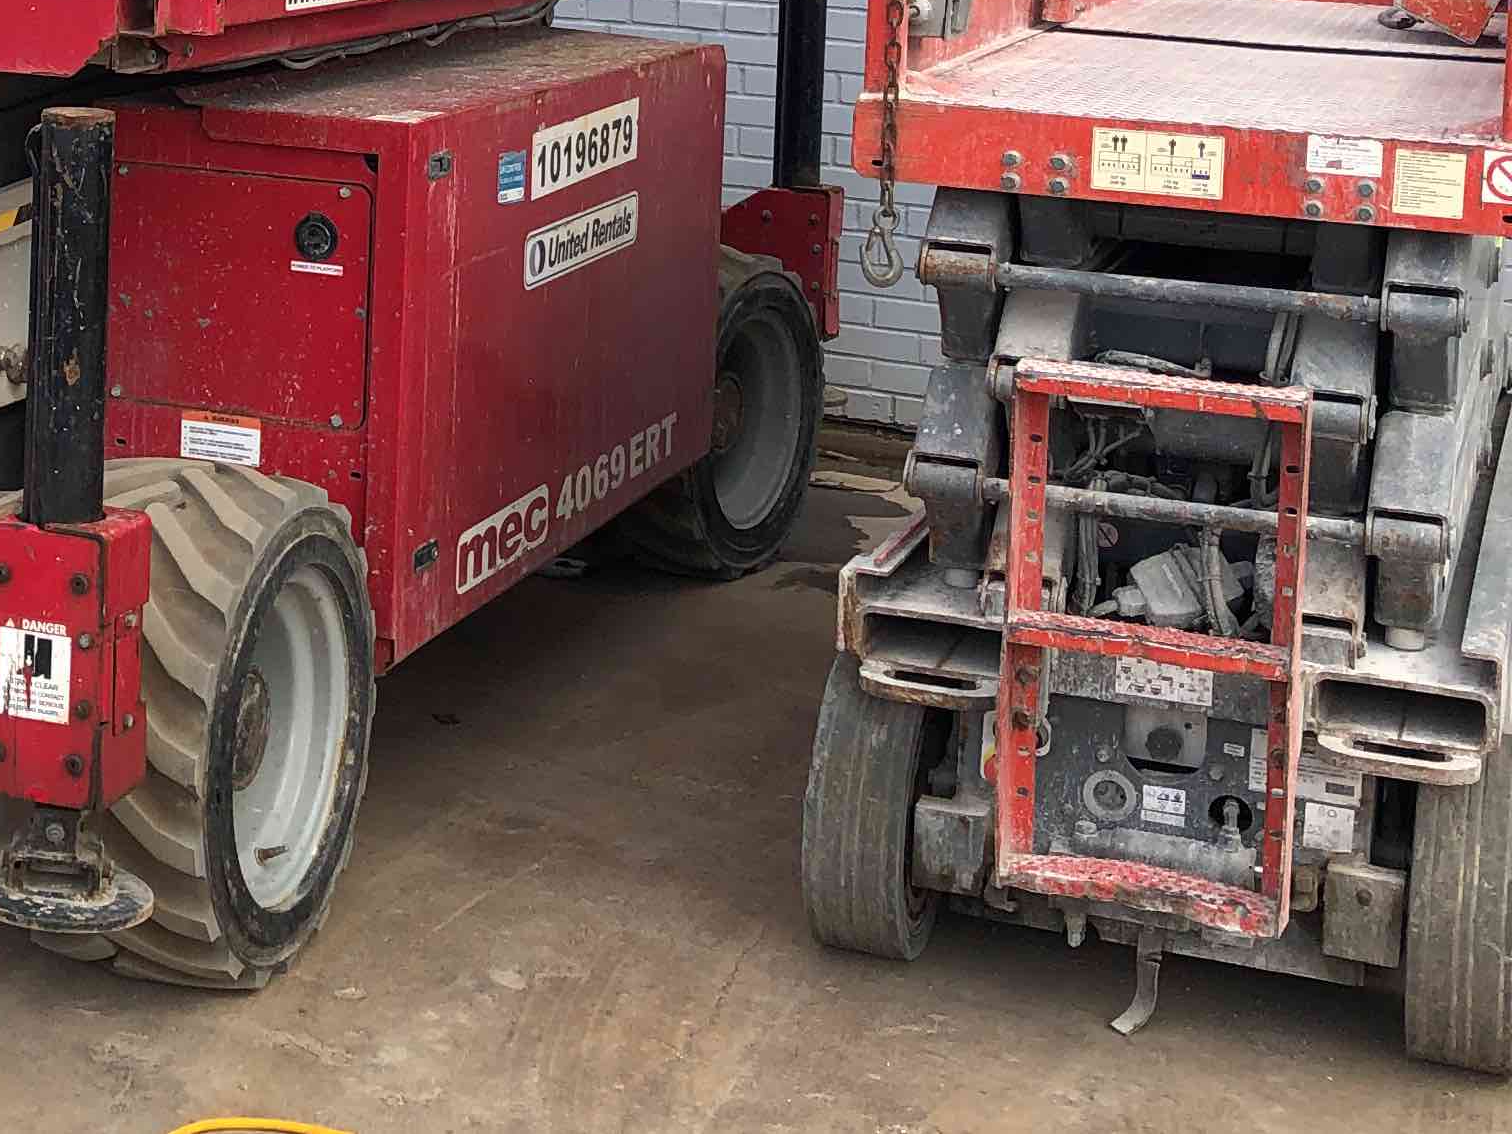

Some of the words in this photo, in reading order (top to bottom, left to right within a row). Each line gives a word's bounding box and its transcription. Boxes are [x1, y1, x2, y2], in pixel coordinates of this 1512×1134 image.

[538, 115, 633, 187] 10196879
[548, 223, 588, 267] United
[591, 207, 631, 250] Rentals
[458, 496, 548, 588] mec
[22, 618, 67, 636] DANGER
